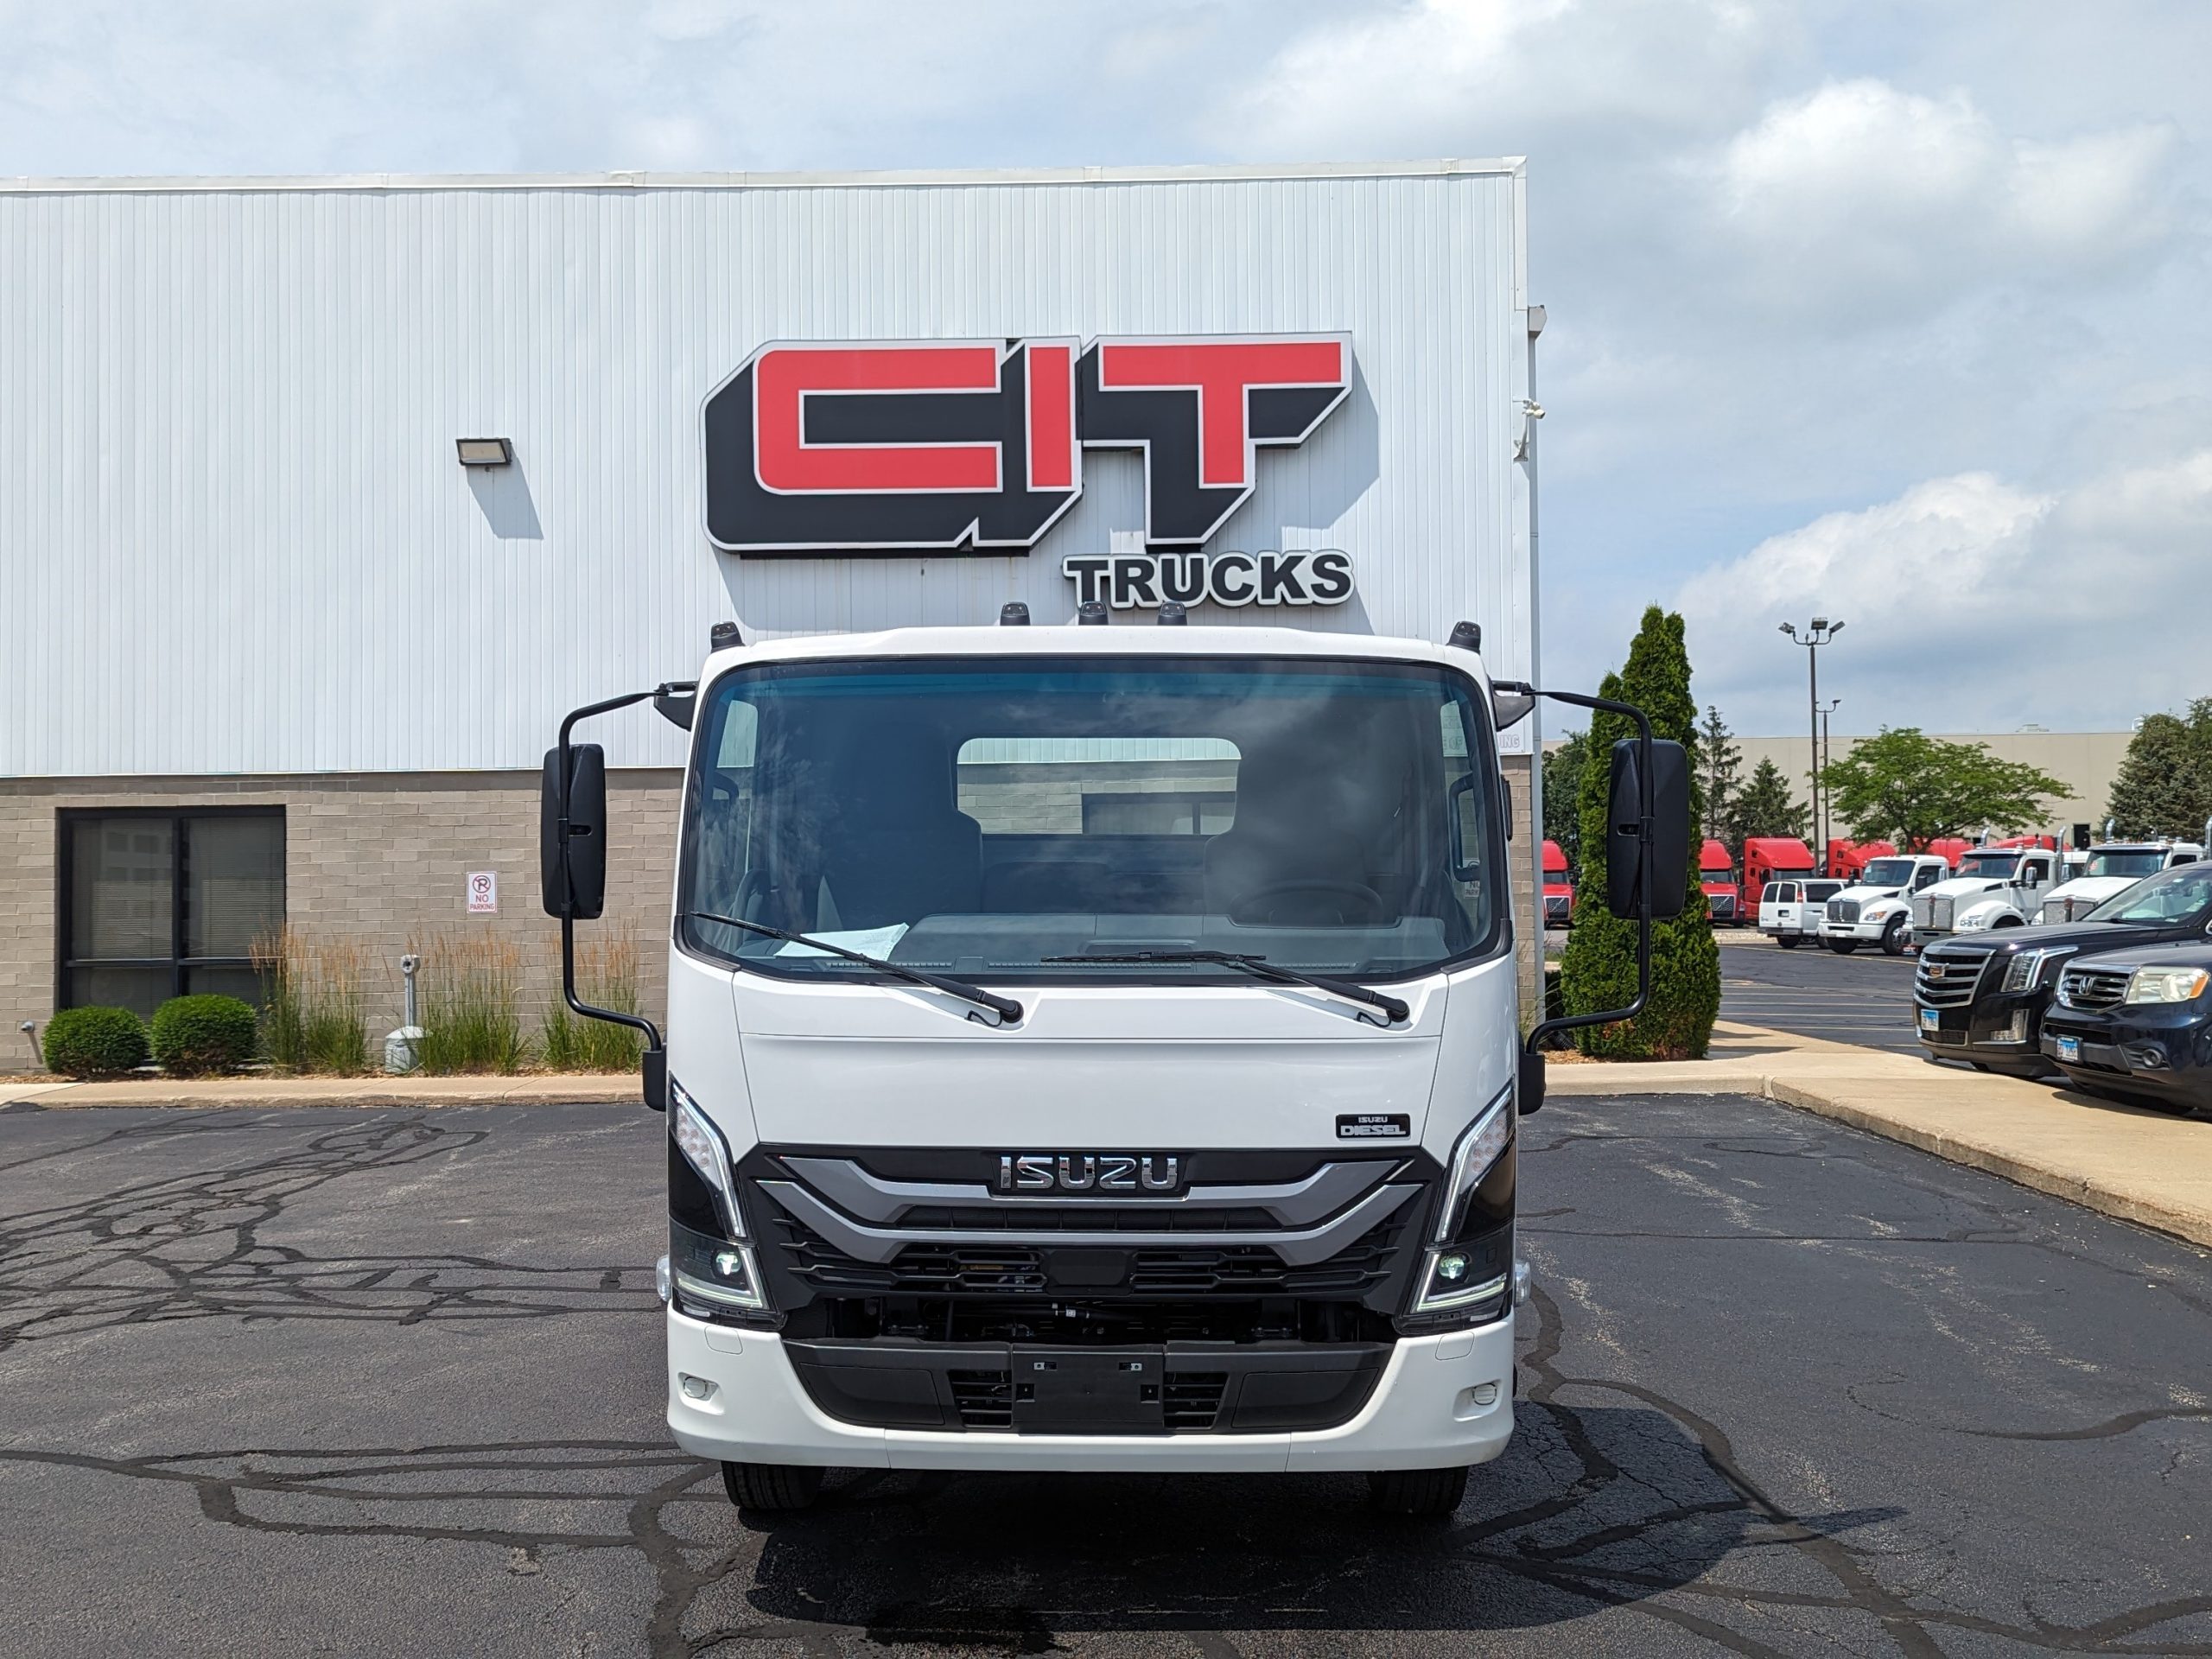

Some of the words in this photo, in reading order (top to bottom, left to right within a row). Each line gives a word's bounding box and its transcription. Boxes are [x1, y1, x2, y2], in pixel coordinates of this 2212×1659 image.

[754, 334, 1352, 494] CIT
[1066, 555, 1352, 603] TRUCKS
[1499, 734, 1519, 748] ING
[1340, 1125, 1406, 1135] DIESEL
[1001, 1156, 1178, 1190] ISUZU
